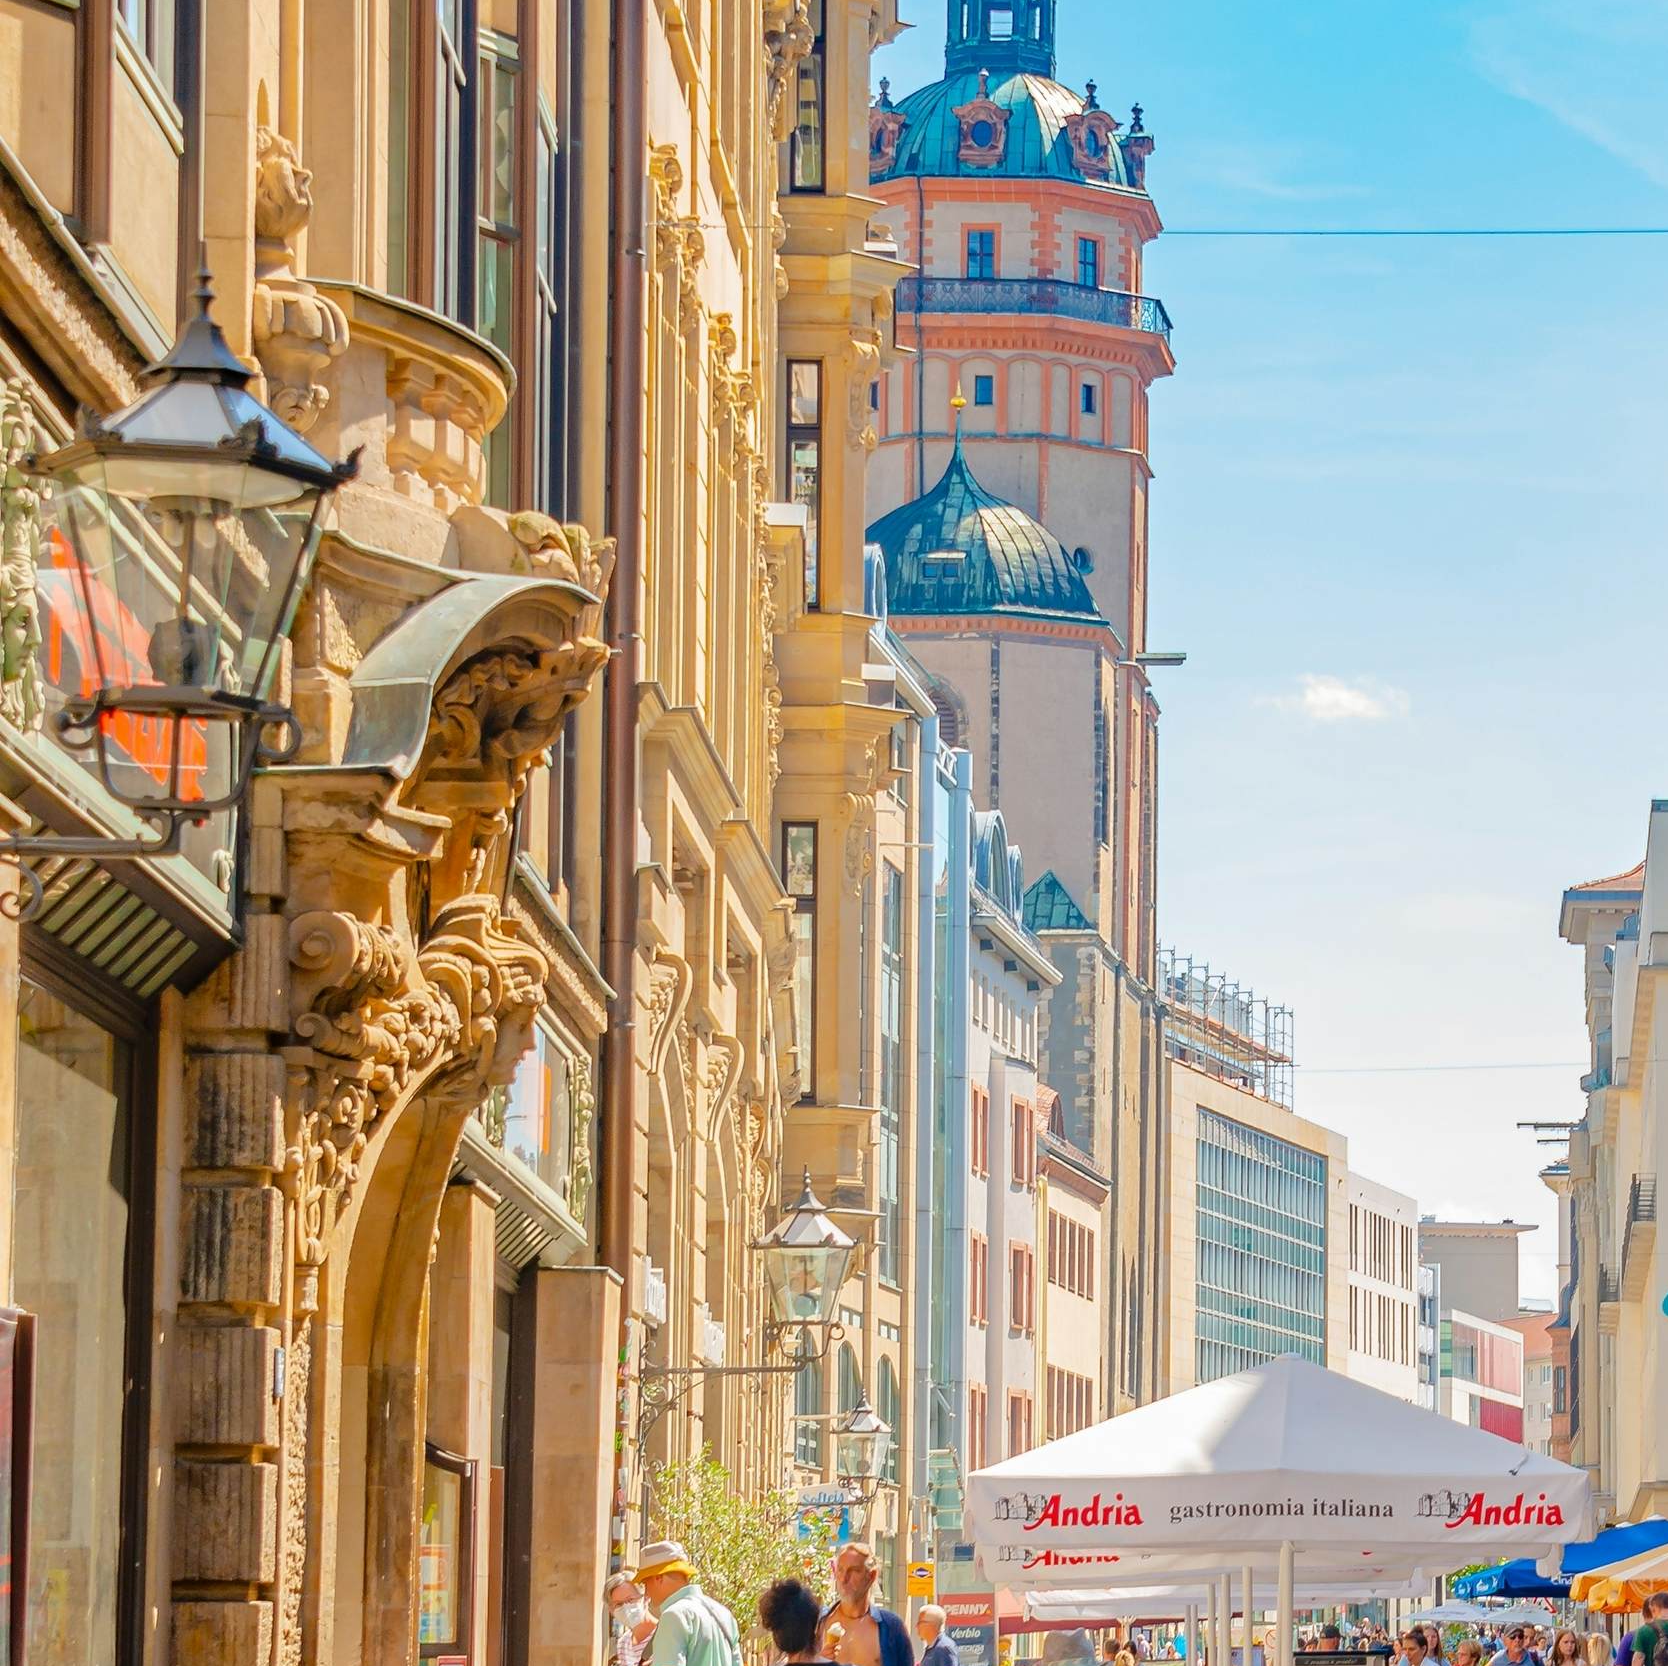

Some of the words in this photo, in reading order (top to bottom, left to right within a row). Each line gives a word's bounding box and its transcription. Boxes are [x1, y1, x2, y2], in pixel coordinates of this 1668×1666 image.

[1023, 1493, 1144, 1531] Andria
[1169, 1499, 1304, 1524] gastronomia
[1312, 1498, 1394, 1518] italiana
[1445, 1493, 1565, 1528] Andria
